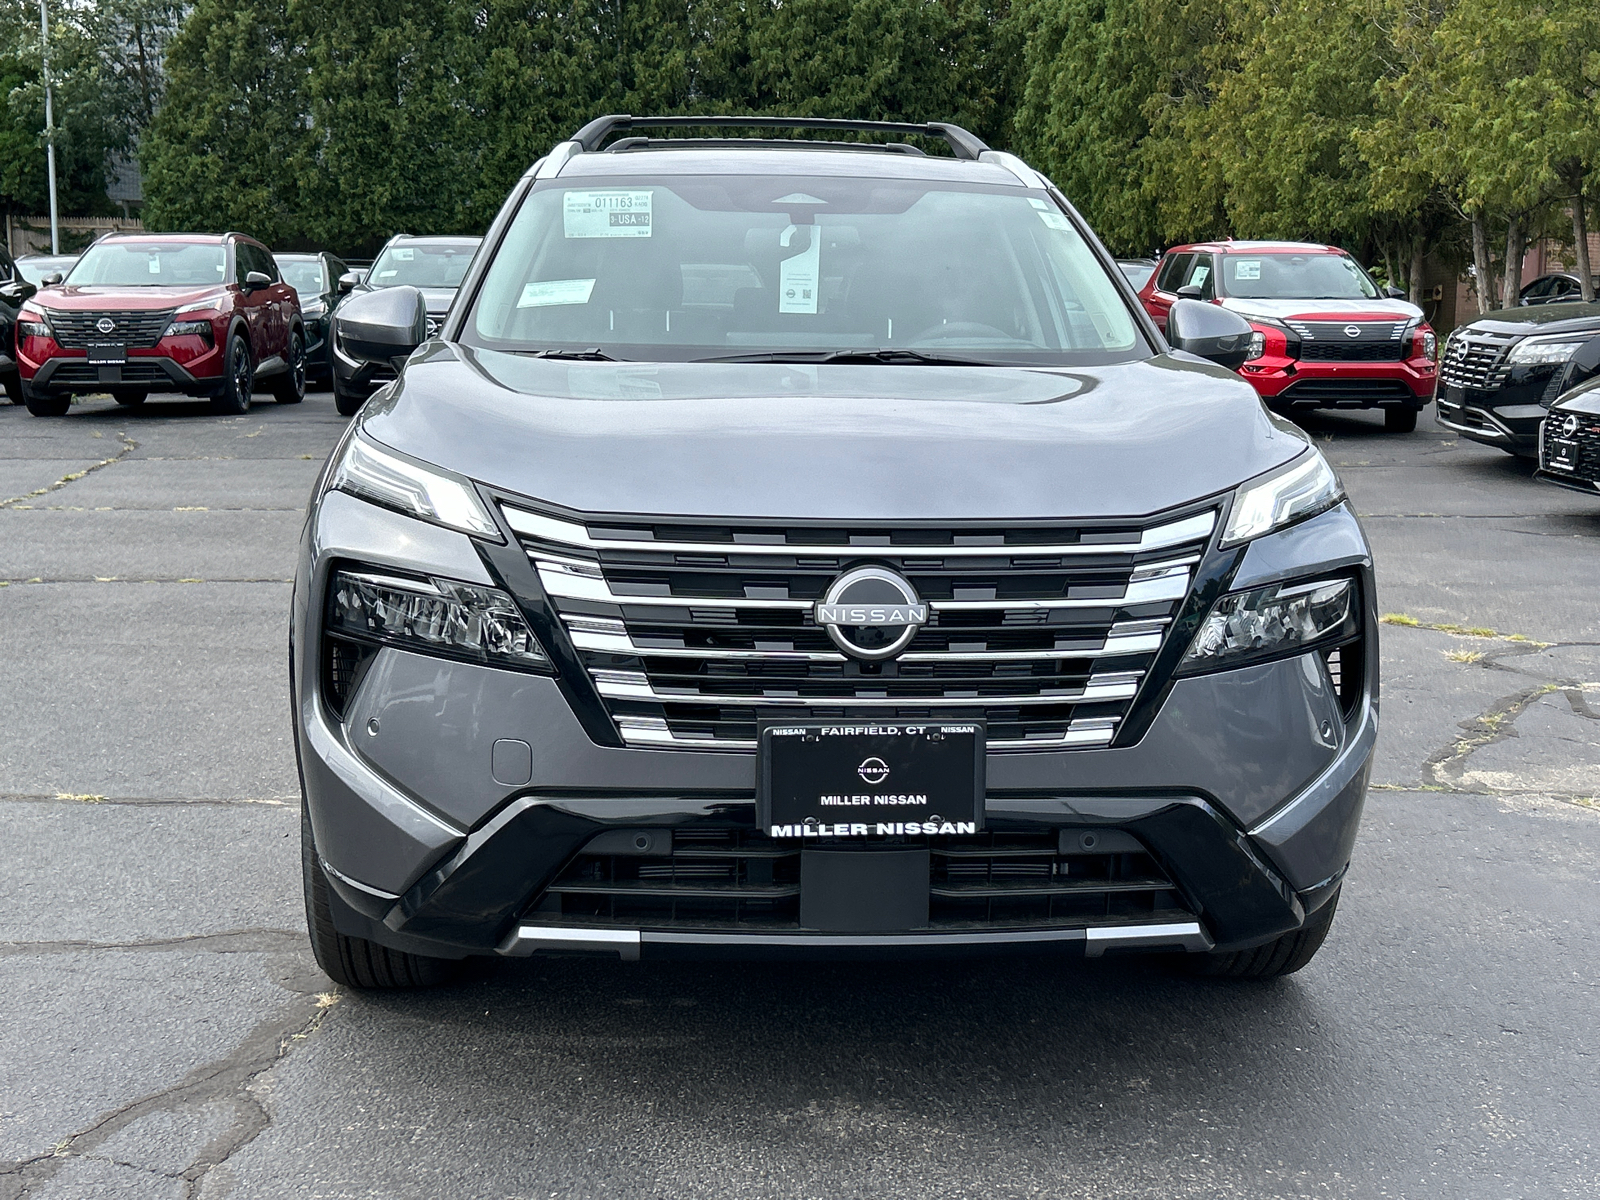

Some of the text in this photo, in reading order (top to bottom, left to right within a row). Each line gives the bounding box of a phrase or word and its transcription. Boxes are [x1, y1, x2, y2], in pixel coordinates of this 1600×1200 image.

[595, 197, 633, 208] 011163
[618, 214, 636, 224] USA
[821, 608, 924, 622] NISSAN
[773, 726, 975, 736] NISSAN FAIRFIELD, CT NISSAN
[820, 795, 927, 806] MILLER NISSAN
[771, 822, 976, 837] MILLER NISSAN
